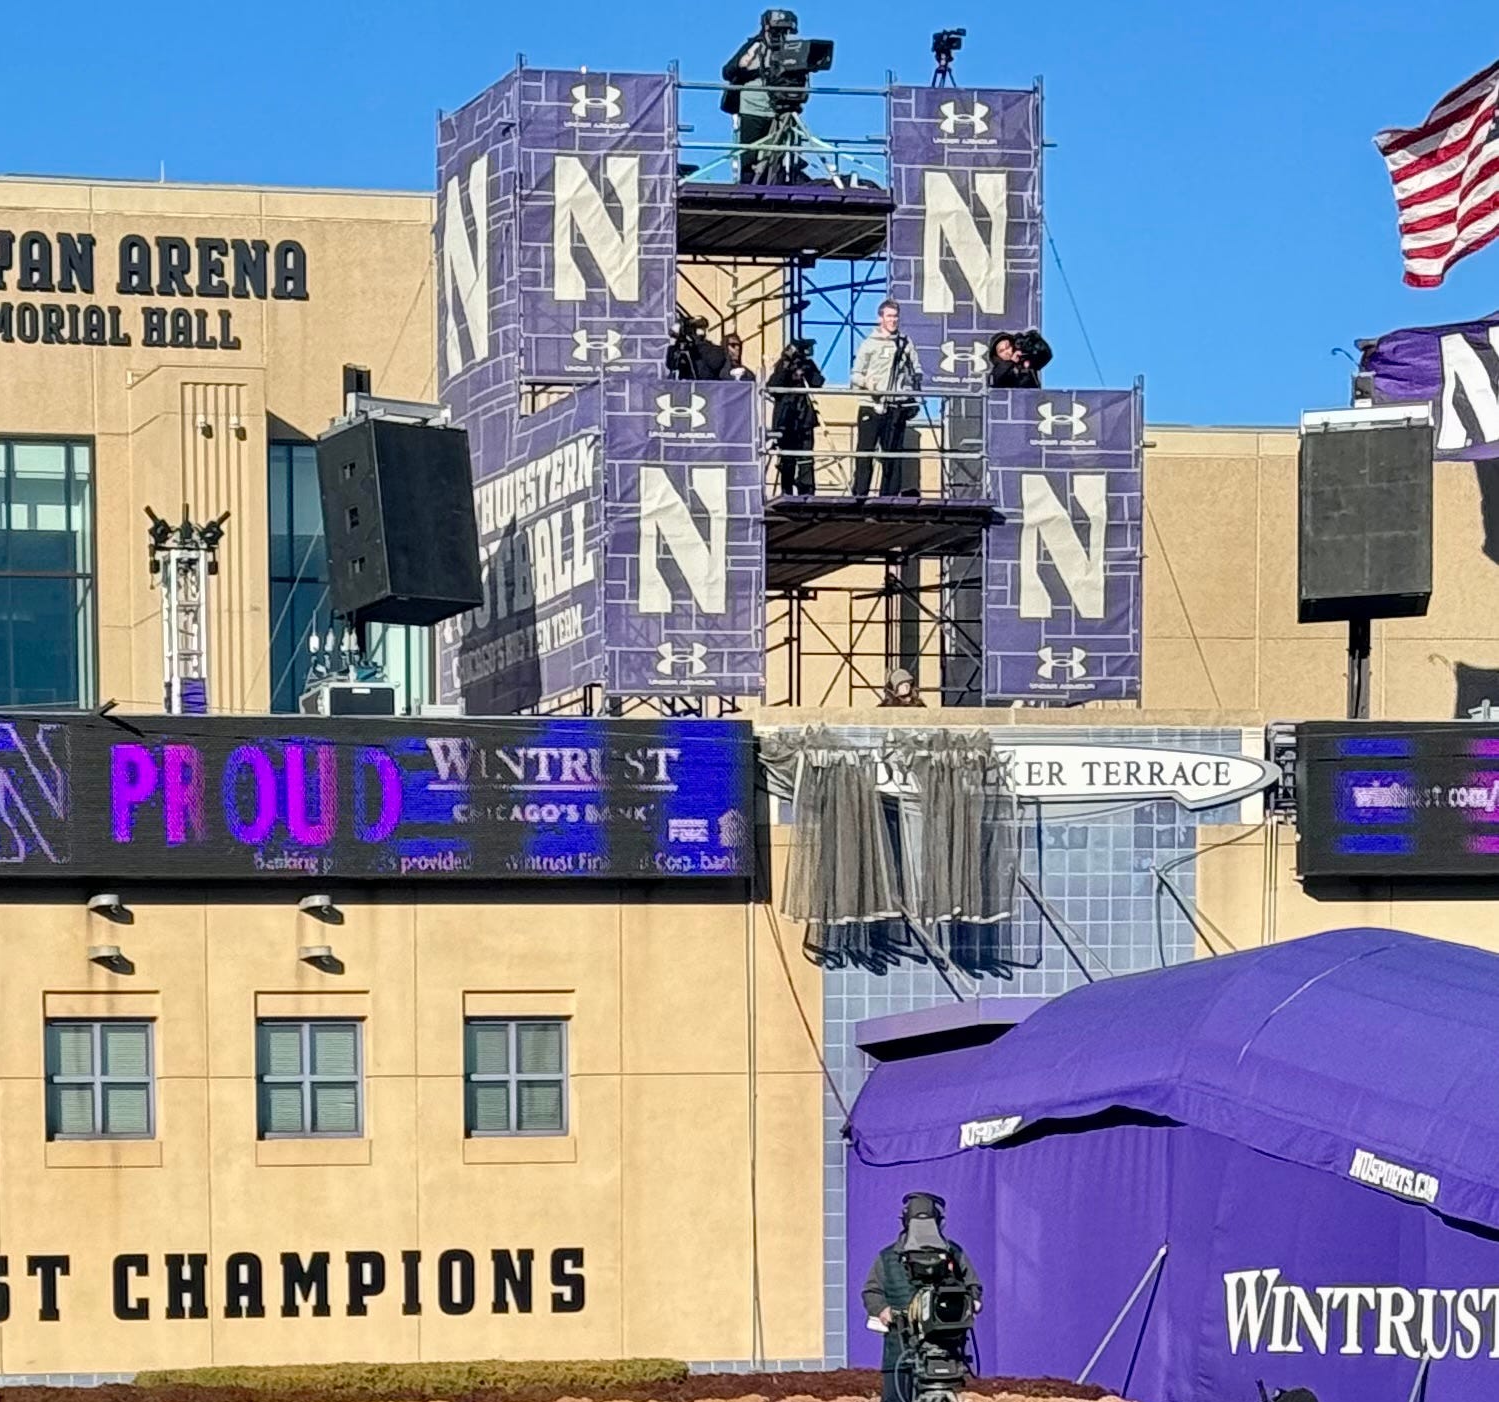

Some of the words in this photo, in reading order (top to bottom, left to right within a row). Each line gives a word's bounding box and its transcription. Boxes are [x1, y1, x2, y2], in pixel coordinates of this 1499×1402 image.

[117, 235, 309, 301] ARENA
[443, 154, 488, 378] N
[554, 156, 641, 302] N
[922, 172, 1006, 314] N
[142, 307, 240, 350] HALL
[1437, 326, 1499, 449] N
[639, 466, 726, 613] N
[1019, 474, 1106, 619] N
[111, 740, 401, 846] PROUD
[1082, 761, 1231, 786] TERRACE
[112, 1247, 586, 1321] CHAMPIONS
[1223, 1268, 1499, 1359] WINTRUST
